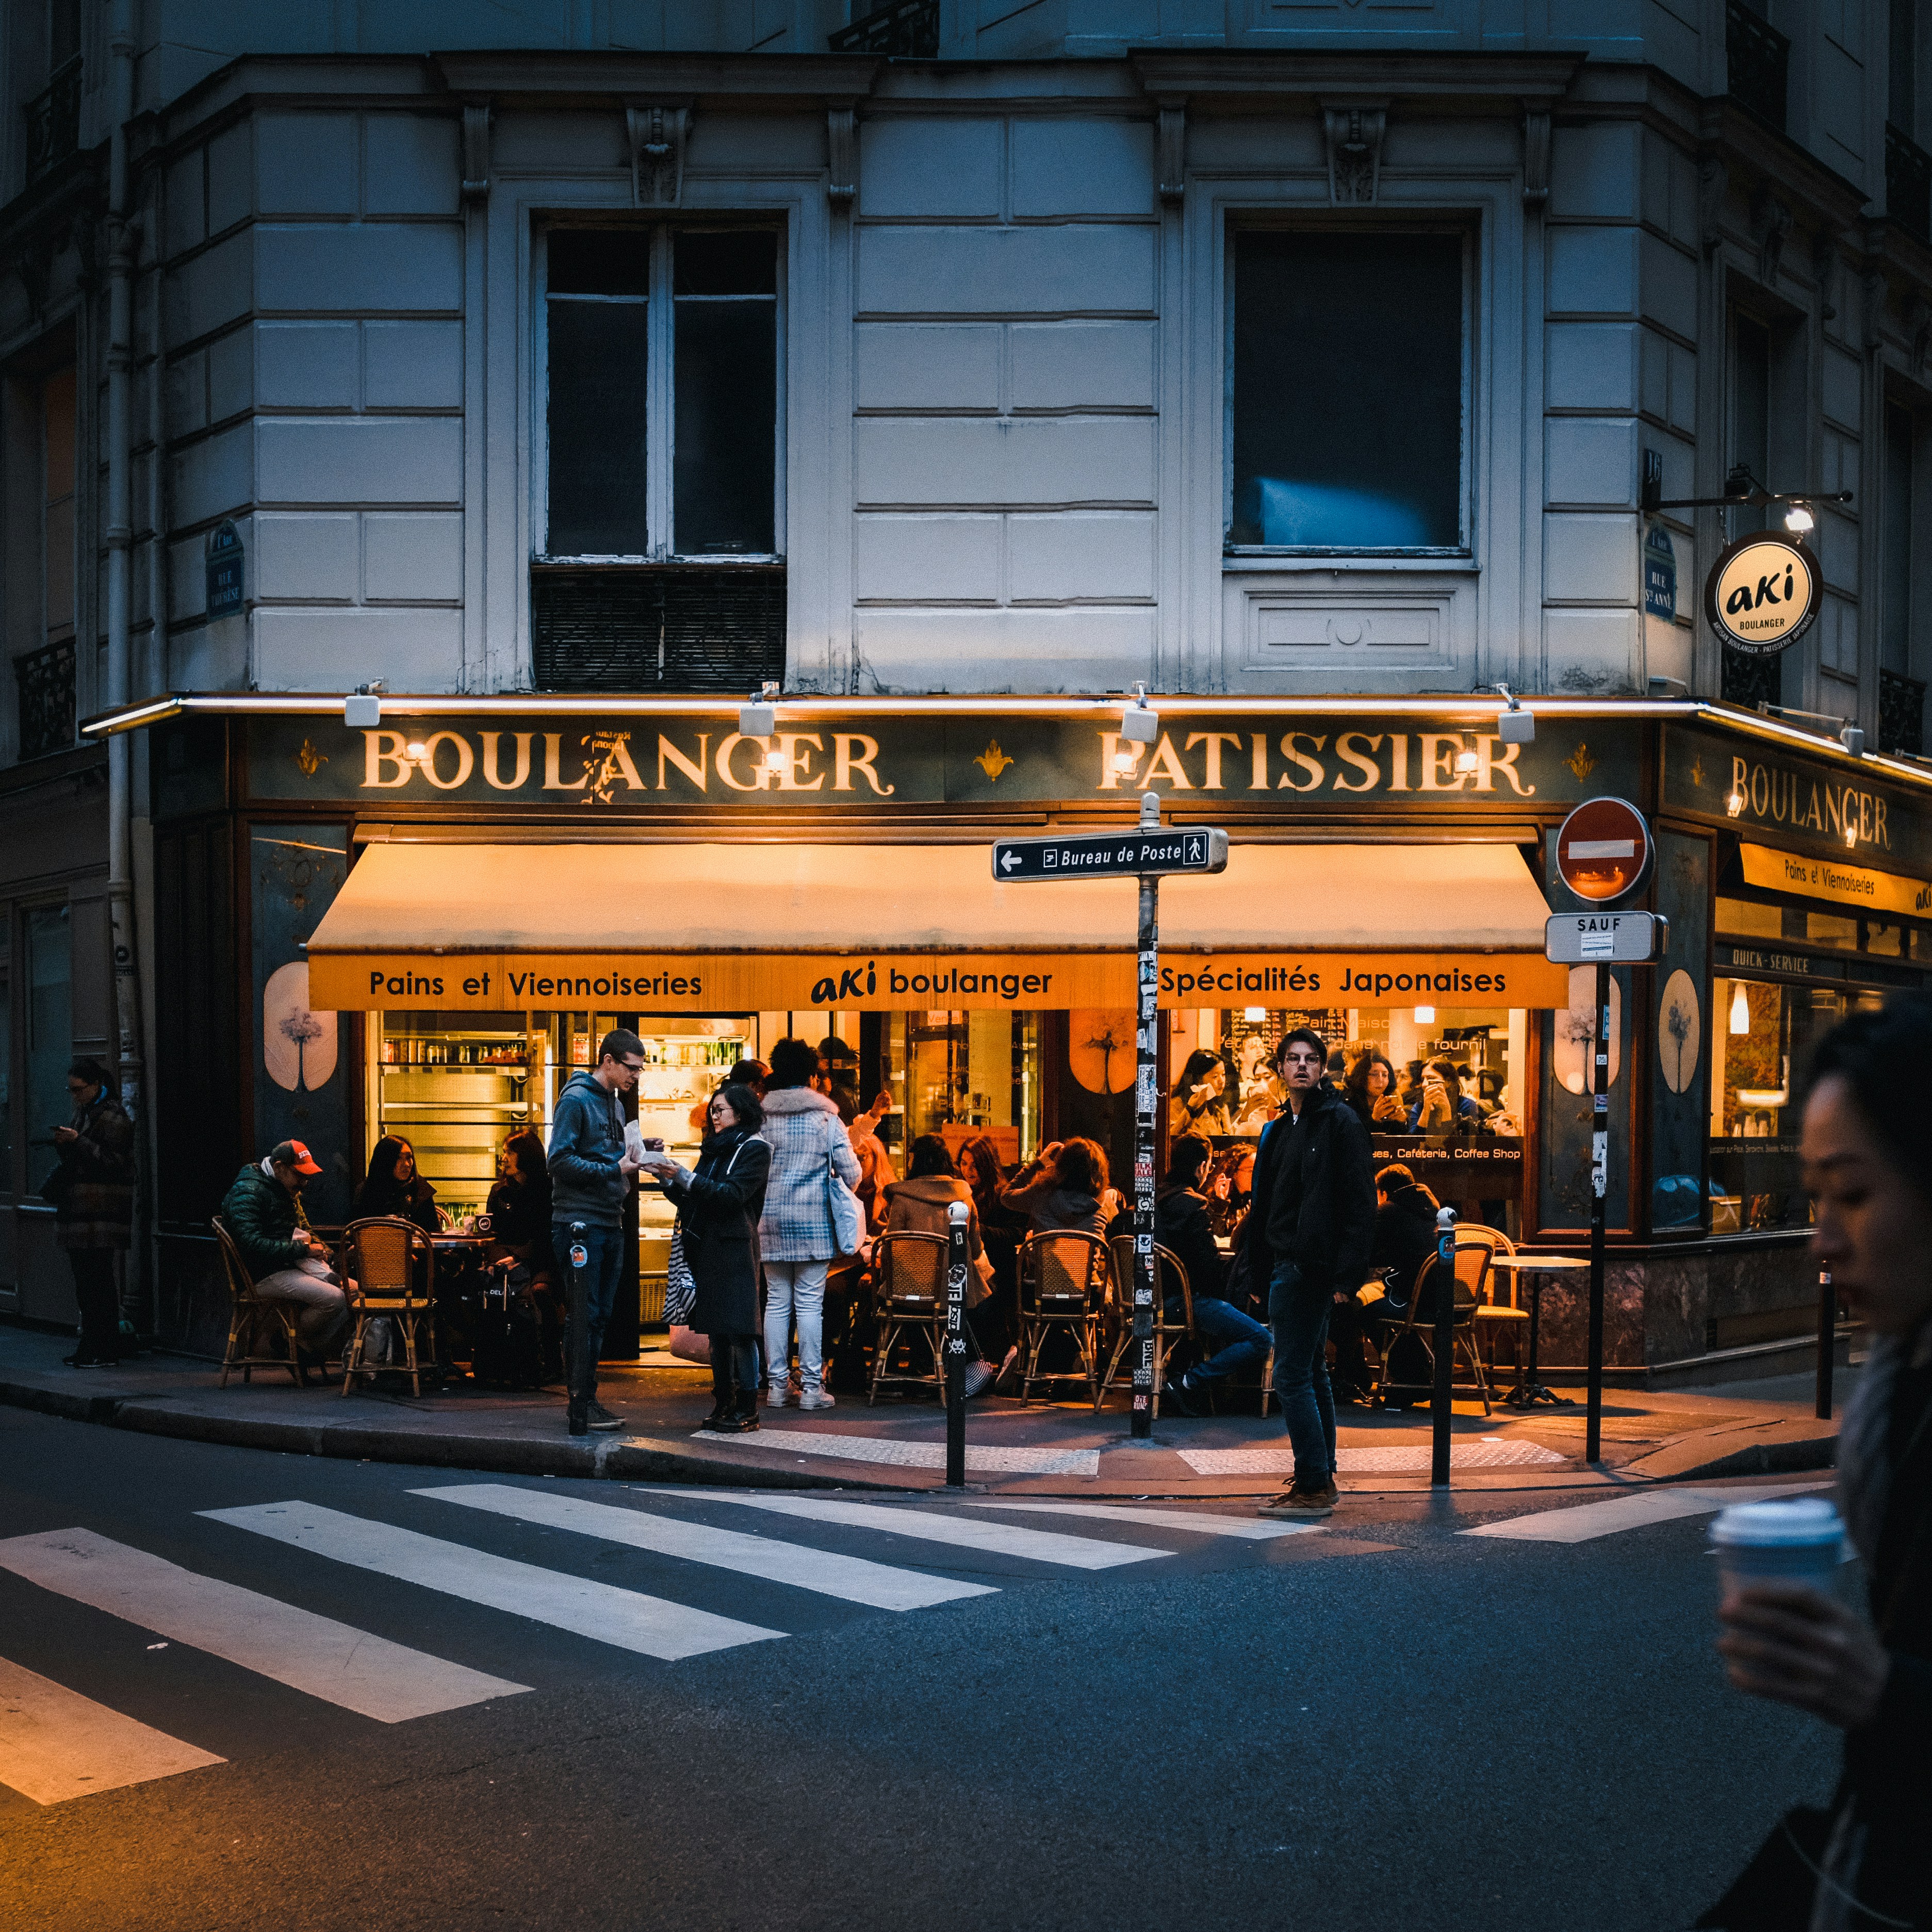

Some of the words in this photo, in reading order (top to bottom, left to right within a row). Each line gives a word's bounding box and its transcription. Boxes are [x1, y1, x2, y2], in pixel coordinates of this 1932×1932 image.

[1652, 571, 1666, 588] RUE
[1740, 618, 1785, 630] BOULANGER
[1727, 637, 1758, 654] BOULANGER
[359, 729, 895, 796] BOULANGER
[1096, 729, 1536, 796] PATISSIER
[1732, 756, 1891, 851] BOULANGER
[1061, 849, 1111, 866] Bureau
[1117, 846, 1135, 862] de
[1140, 843, 1182, 860] Poste
[1785, 859, 1807, 882] Pains
[1811, 865, 1819, 884] et
[1823, 868, 1875, 895] Viennoiseries
[1577, 918, 1621, 932] SAUF
[370, 972, 444, 995] Pains
[462, 972, 490, 996] et
[508, 971, 702, 996] Viennoiseries
[890, 968, 1053, 1000] boulanger
[1160, 965, 1320, 997] Spécialités
[1339, 967, 1507, 997] Japonaises
[1434, 1038, 1486, 1050] fournil
[1454, 1149, 1489, 1158] Coffee
[1493, 1149, 1520, 1159] Shop
